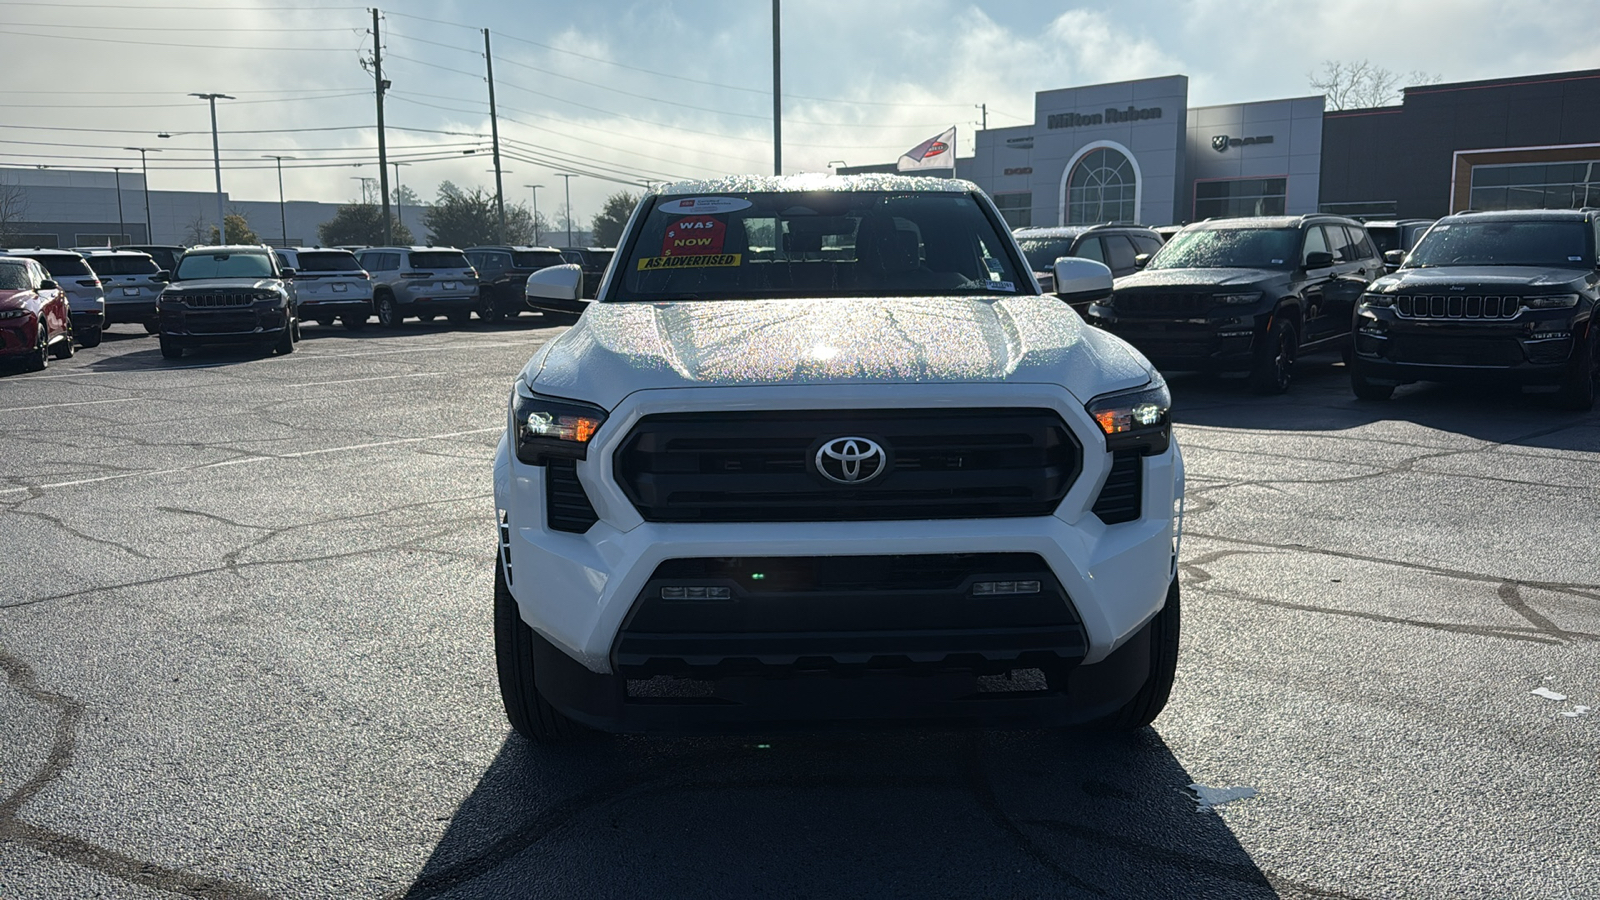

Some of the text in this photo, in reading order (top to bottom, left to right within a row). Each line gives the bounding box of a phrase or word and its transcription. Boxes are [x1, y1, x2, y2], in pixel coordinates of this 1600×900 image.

[1047, 113, 1103, 129] Milton
[1229, 135, 1274, 147] RAM
[680, 221, 714, 229] WAS
[668, 230, 675, 238] $
[674, 238, 712, 247] NOW
[644, 254, 735, 268] AS ADVERTISED
